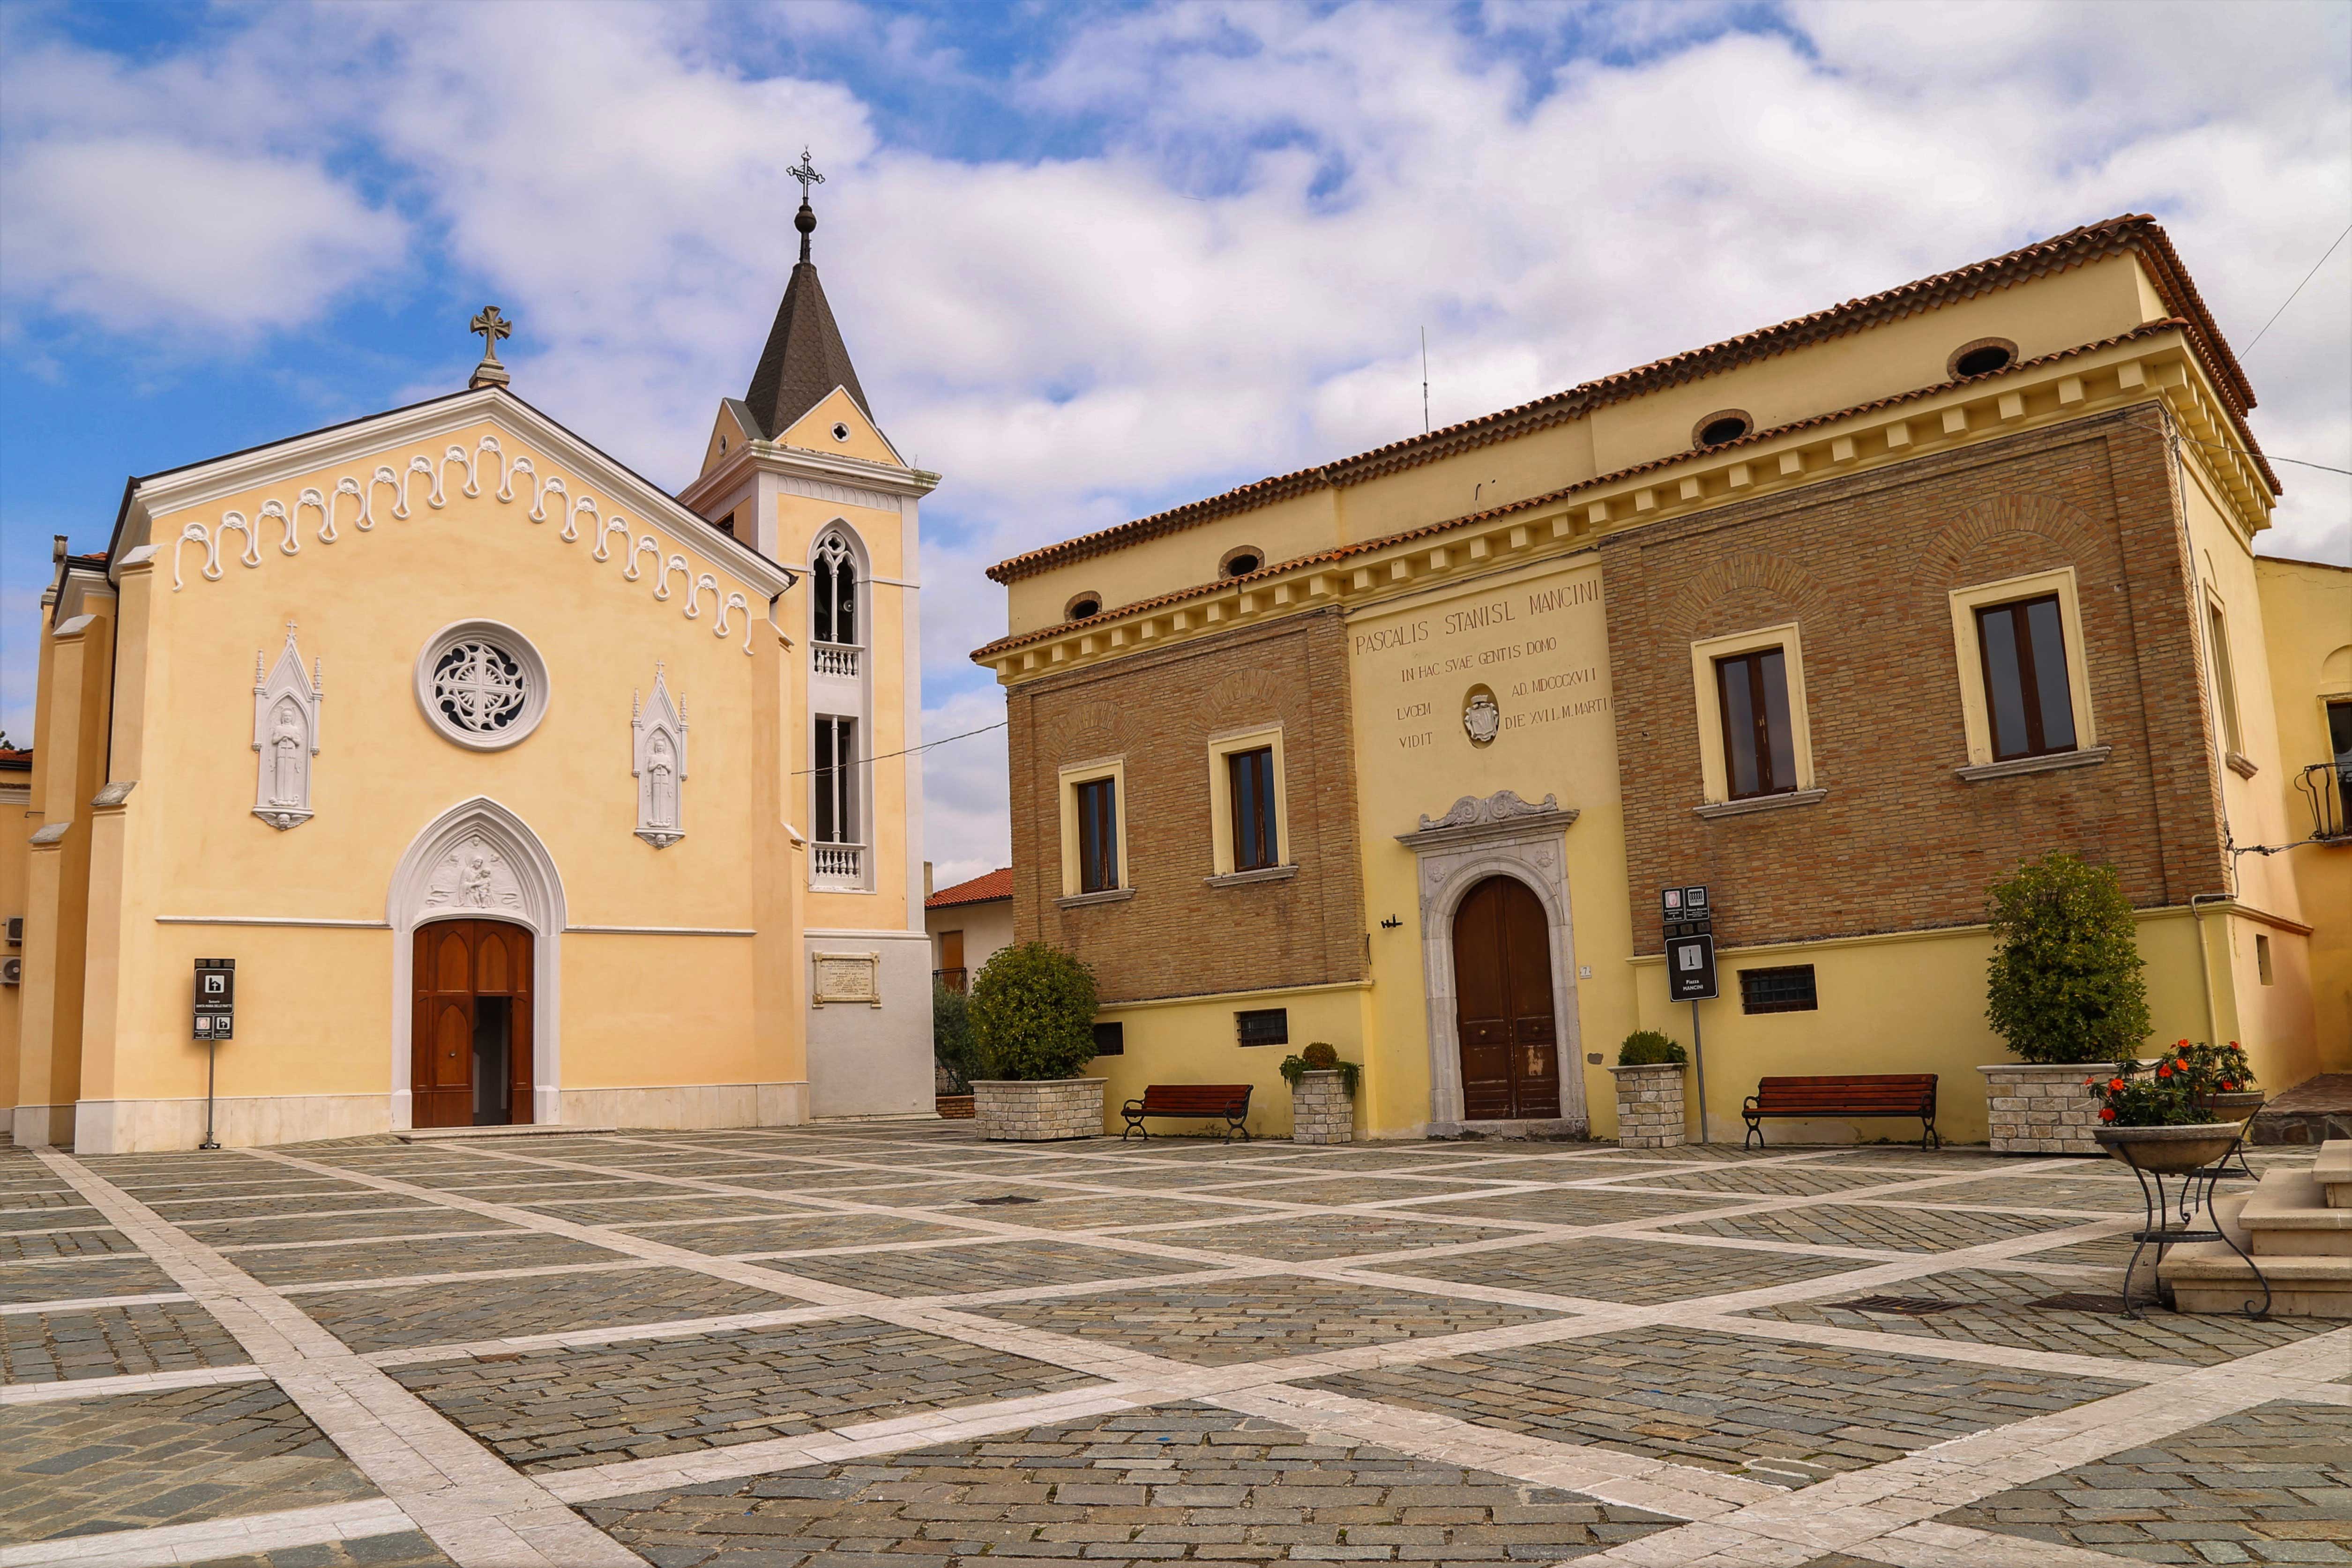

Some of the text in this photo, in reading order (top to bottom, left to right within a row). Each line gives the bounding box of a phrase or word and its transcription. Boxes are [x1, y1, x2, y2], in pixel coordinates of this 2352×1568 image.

[1356, 580, 1598, 655] PASCALIS STANISL MANCINI
[1402, 637, 1557, 682] IN HAC SVAE GENTIS DOMO
[1512, 668, 1596, 697] AD. MDCCCXVII
[1397, 702, 1431, 720] LVCEM
[1505, 713, 1526, 729] DIE
[1575, 696, 1614, 716] MARTII
[1399, 732, 1432, 748] VIDIT
